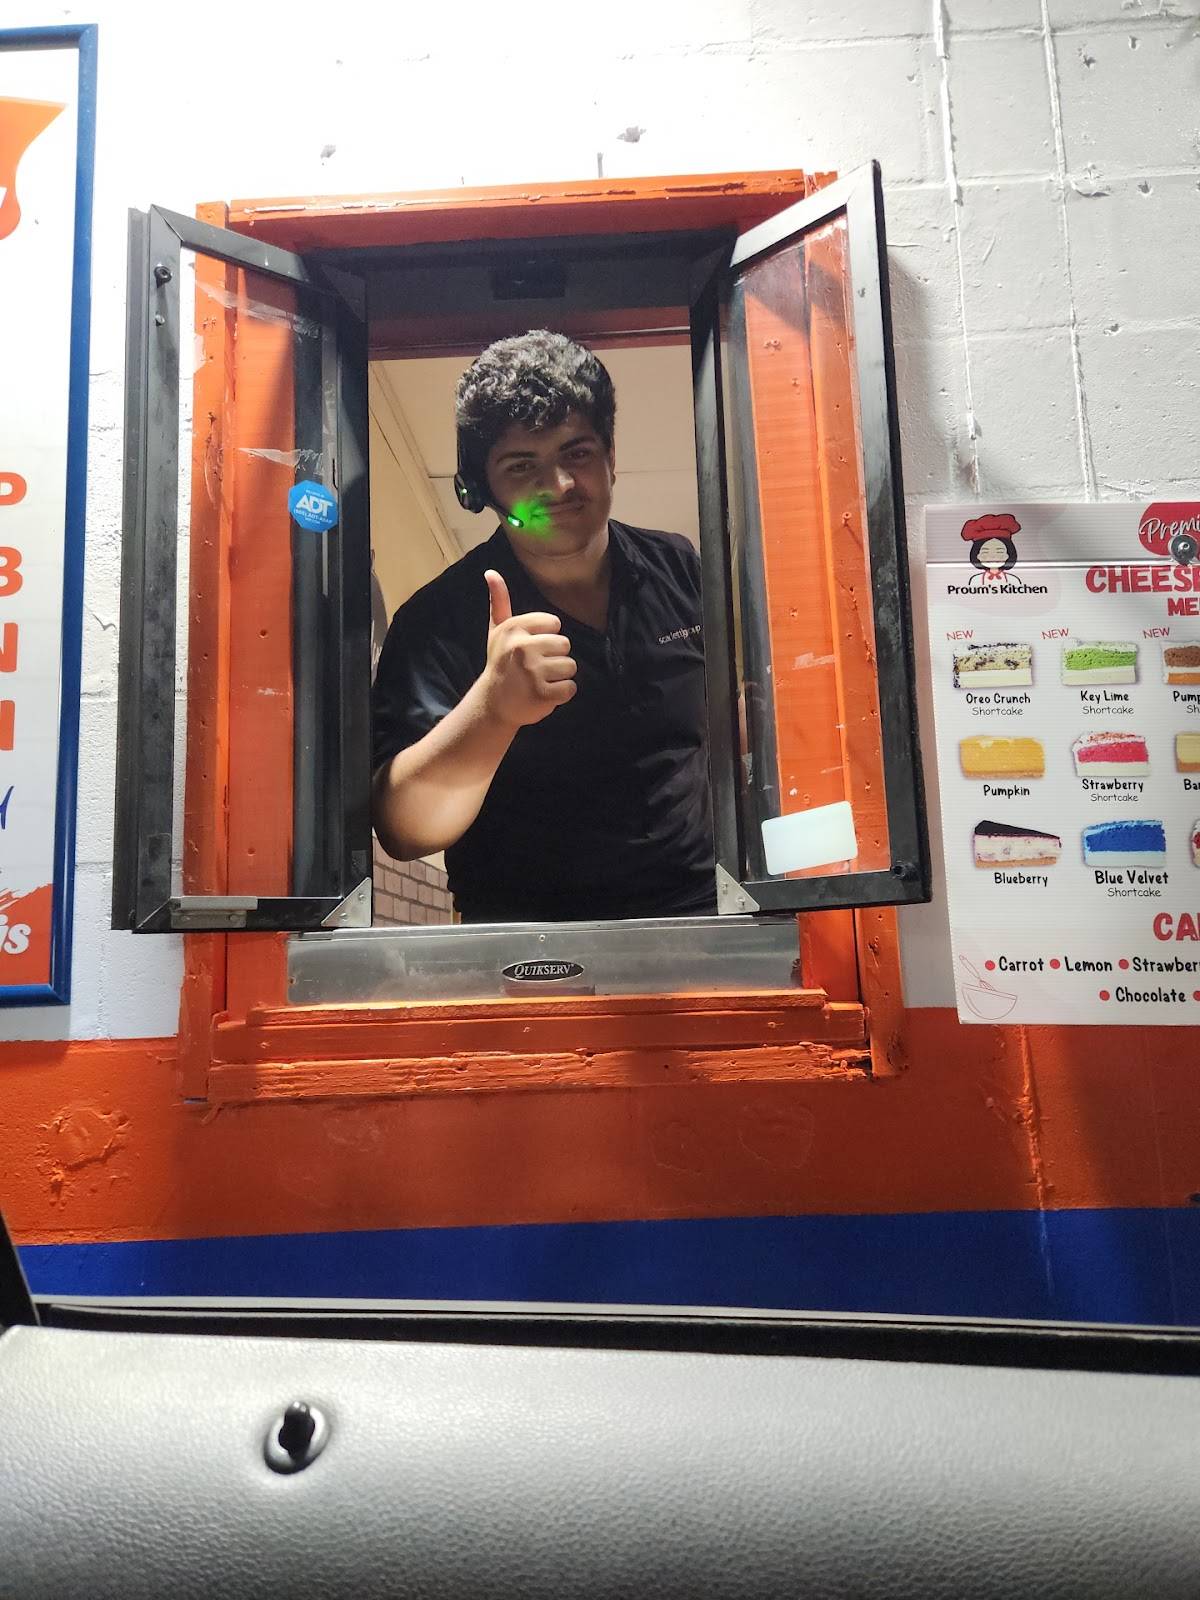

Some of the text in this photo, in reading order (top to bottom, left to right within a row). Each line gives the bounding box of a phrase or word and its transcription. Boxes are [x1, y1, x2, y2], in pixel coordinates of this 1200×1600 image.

[296, 494, 334, 518] ADT
[947, 583, 1048, 595] Proum's Kitchen
[1167, 597, 1200, 616] ME
[946, 630, 974, 641] NEW
[1041, 628, 1069, 640] NEW
[1143, 627, 1171, 640] NEW
[965, 692, 1031, 704] Oreo Crunch
[1080, 690, 1129, 706] Key Lime
[972, 706, 1023, 716] Shortcake
[1082, 705, 1134, 715] Shortcake
[1186, 704, 1200, 714] Sh
[983, 785, 1030, 798] Pumpkin
[1082, 779, 1144, 792] Strawberry
[1090, 793, 1139, 803] Shortcake
[994, 872, 1048, 887] Blueberry
[1095, 870, 1169, 885] Blue Velvet
[1107, 886, 1162, 897] Shortcake
[1153, 912, 1200, 942] CA
[998, 956, 1200, 972] Carrot Lemon Strawber
[514, 964, 571, 979] QUIKSERV
[1115, 986, 1186, 1002] Chocolate
